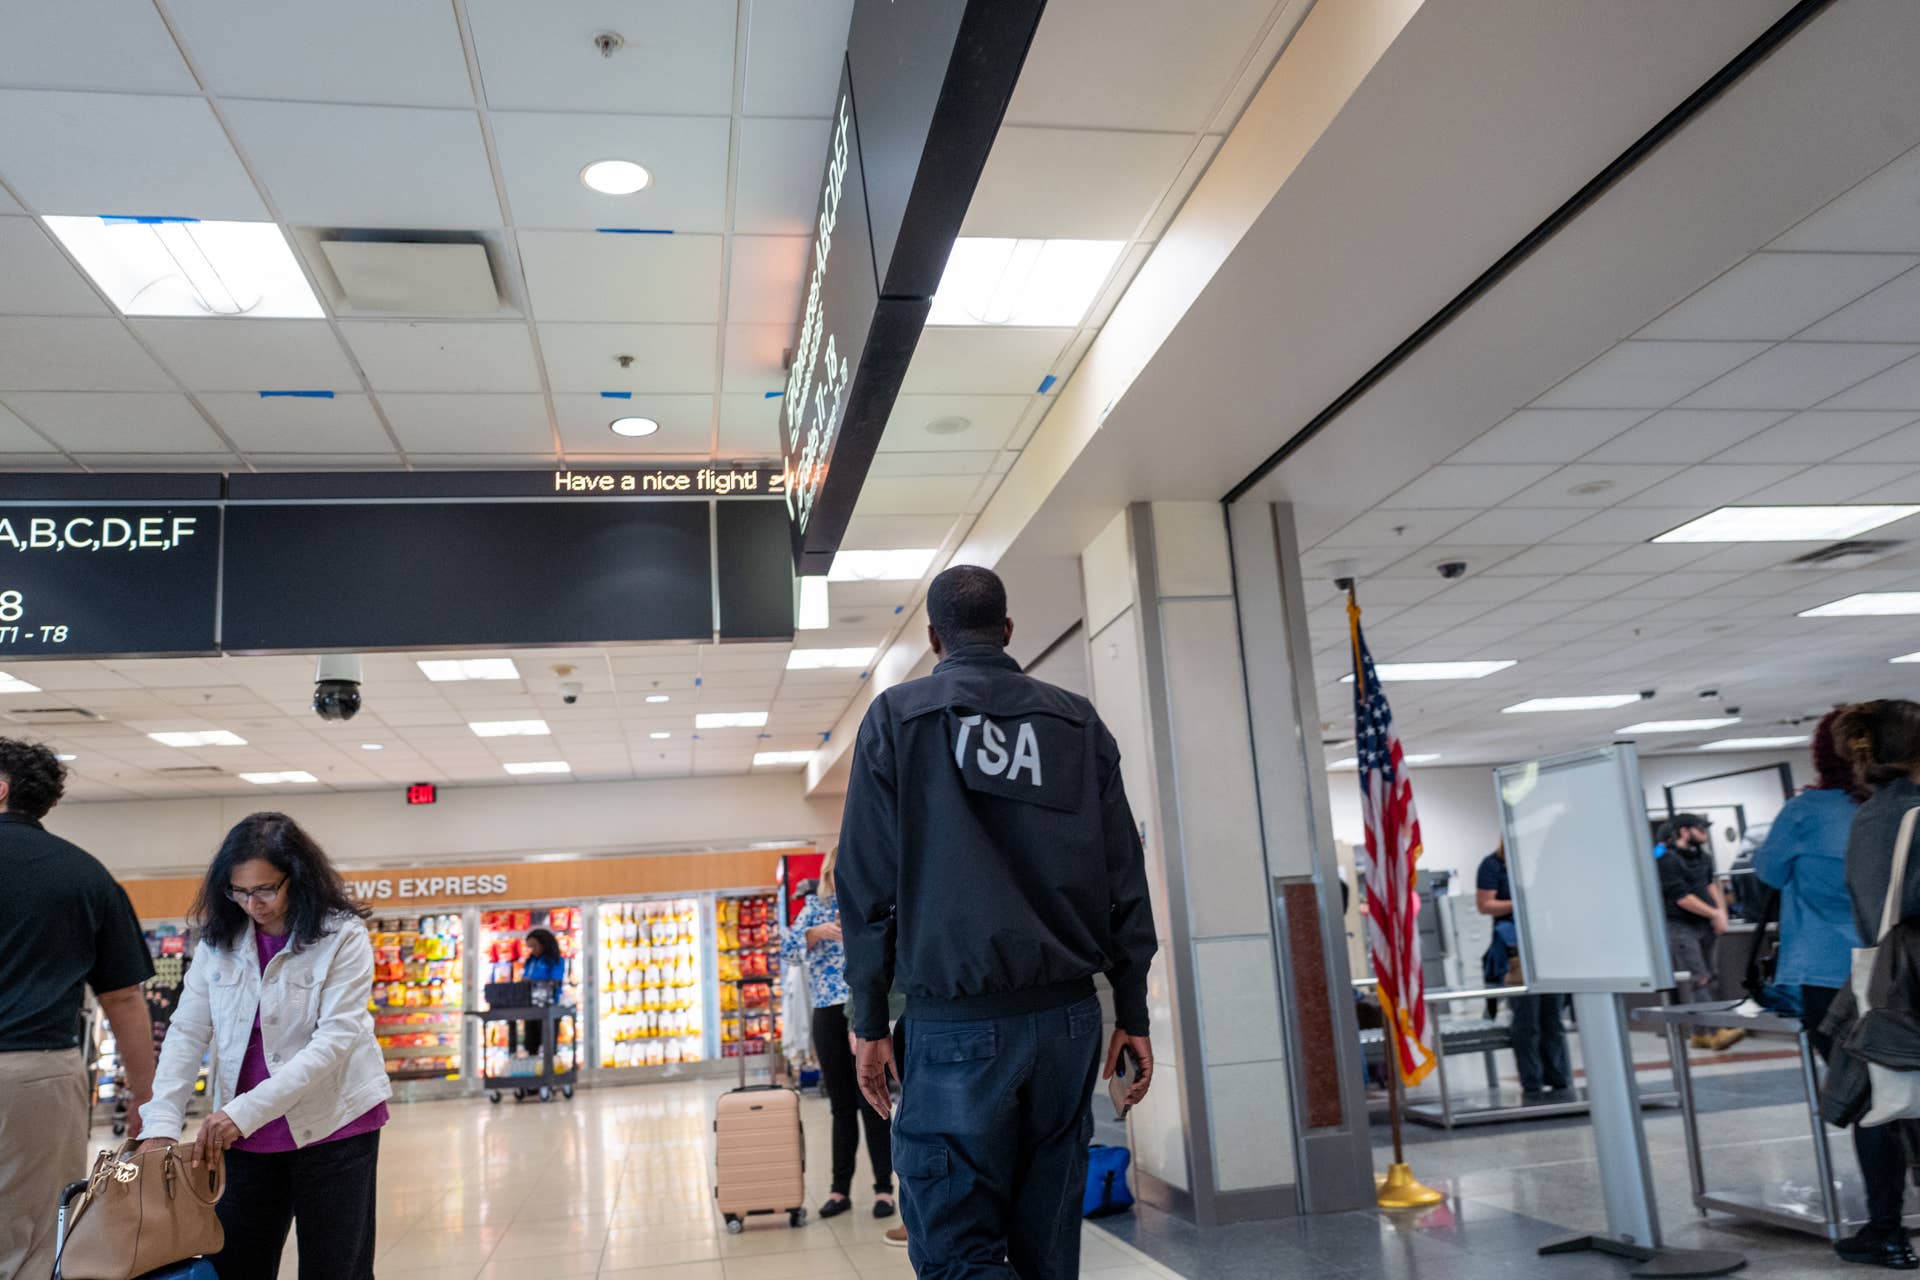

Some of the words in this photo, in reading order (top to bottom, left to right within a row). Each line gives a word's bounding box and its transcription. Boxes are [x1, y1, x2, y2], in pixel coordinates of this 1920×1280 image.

[554, 471, 615, 492] Have
[620, 475, 636, 491] a
[642, 470, 690, 491] nice
[697, 469, 758, 495] flight!
[40, 625, 69, 643] T8
[954, 714, 1042, 787] TSA
[342, 879, 393, 900] EWS
[398, 874, 508, 898] EXPRESS
